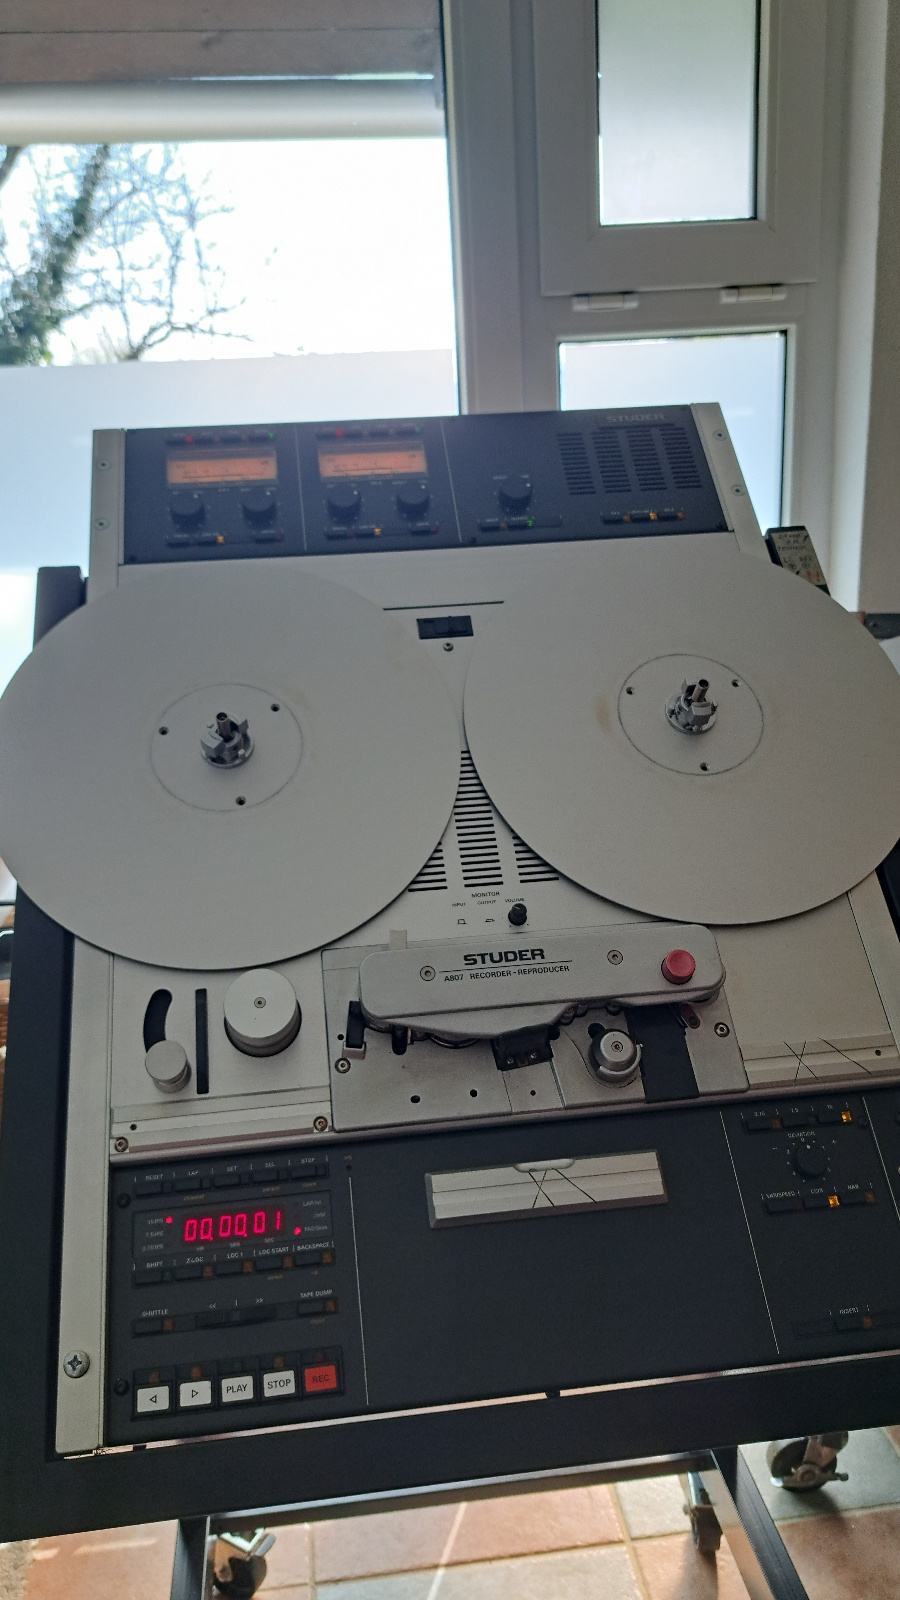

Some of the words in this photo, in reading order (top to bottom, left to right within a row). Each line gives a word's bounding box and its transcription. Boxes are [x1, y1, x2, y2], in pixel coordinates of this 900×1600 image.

[463, 948, 545, 966] STUDER
[444, 973, 464, 983] A807
[300, 1290, 314, 1298] TAPE
[315, 1288, 333, 1296] DUMP
[142, 1308, 168, 1317] SHUTTLE
[267, 1378, 291, 1389] STOP
[312, 1374, 330, 1383] REC
[226, 1383, 247, 1394] PLAY
